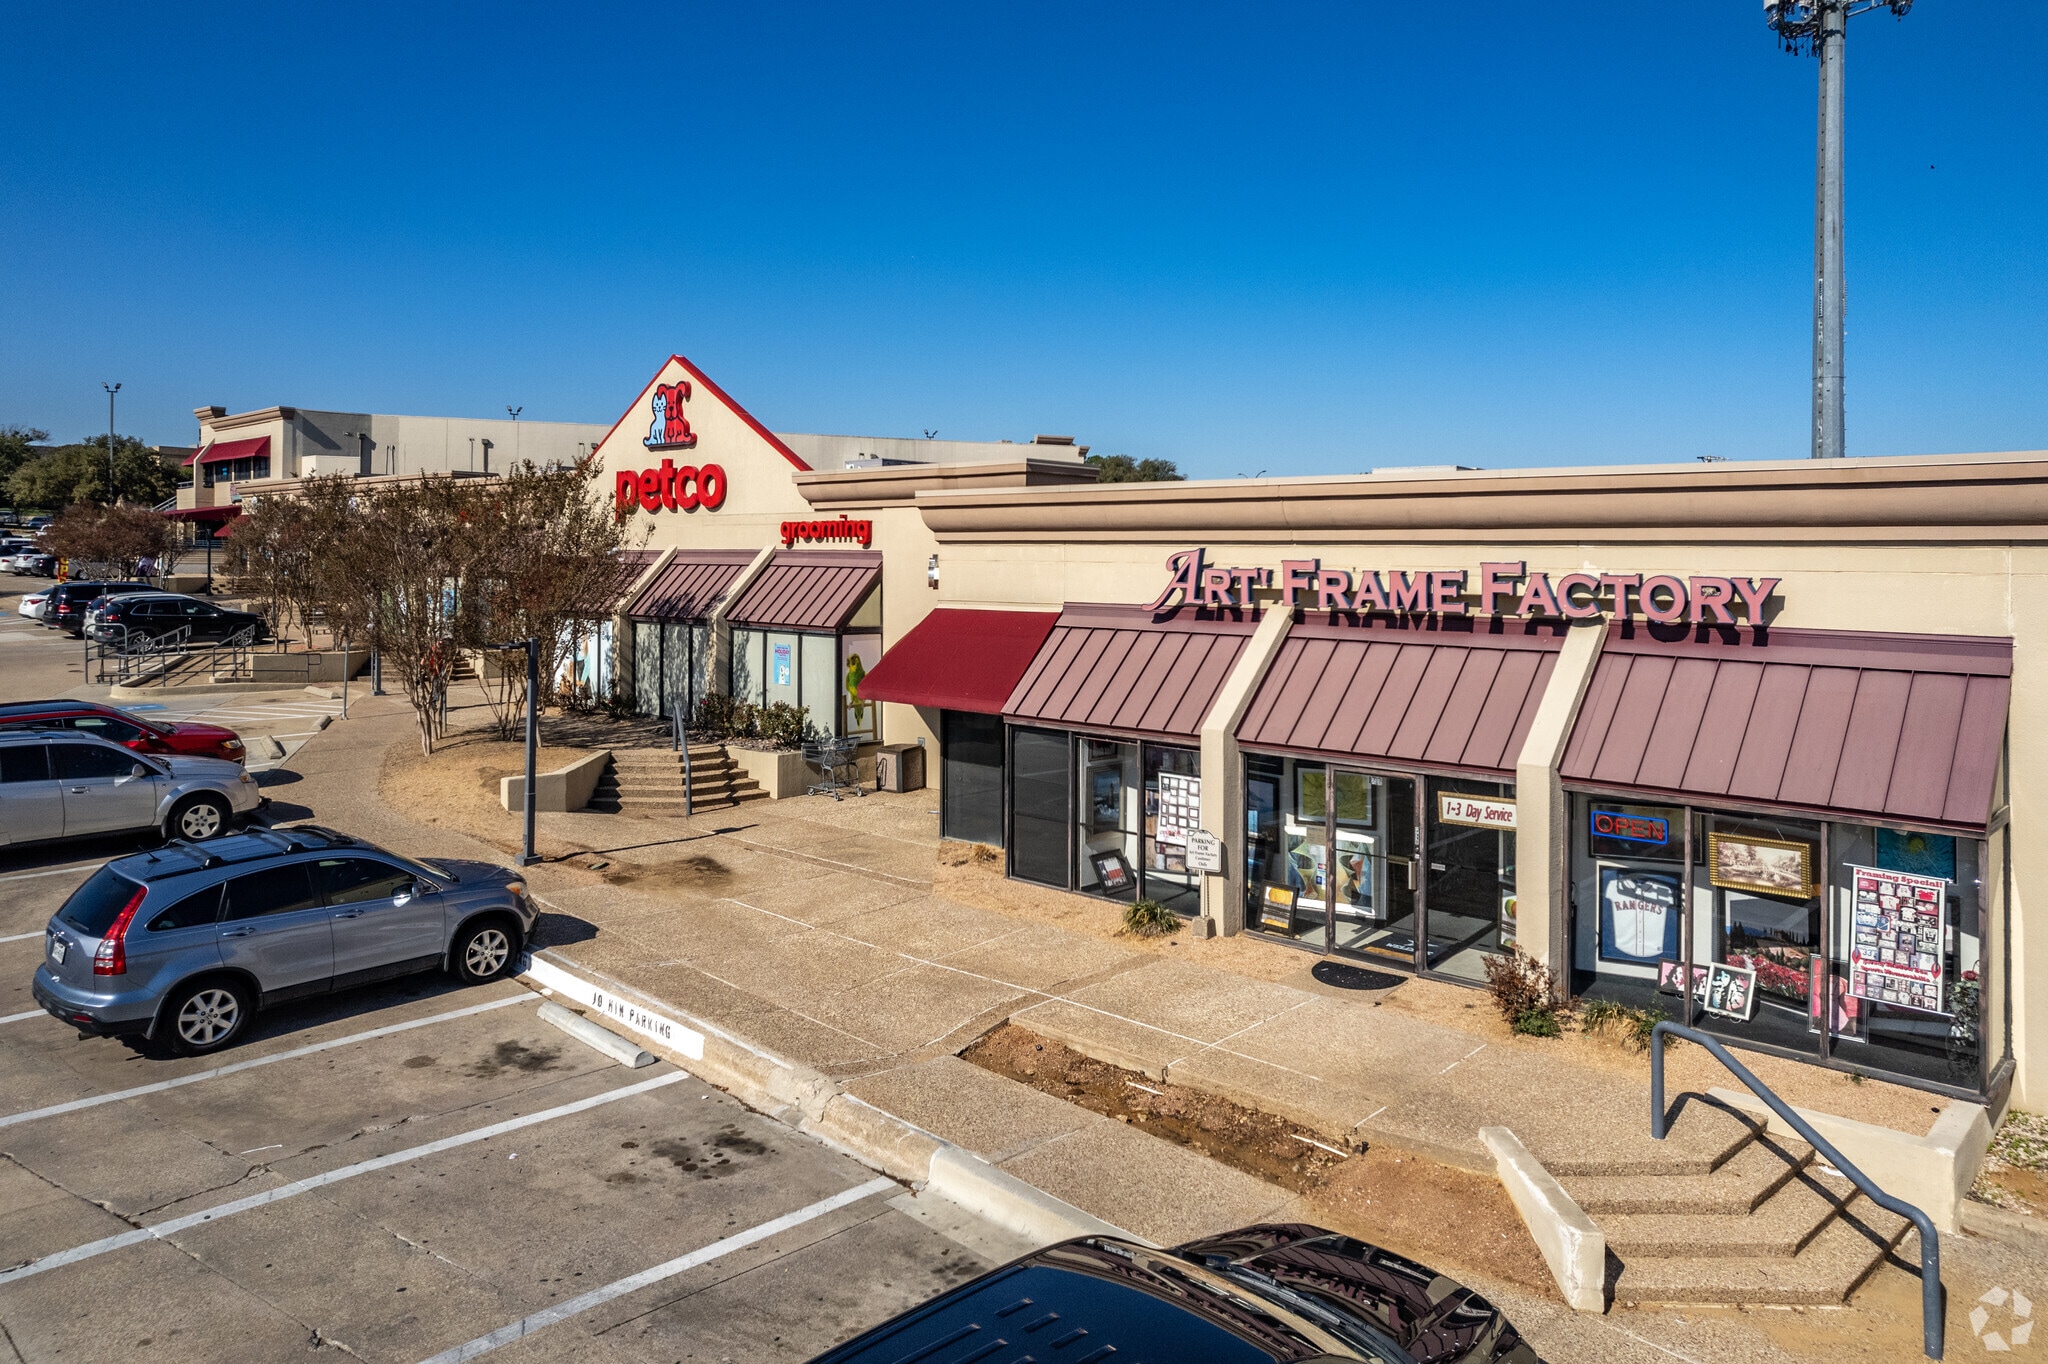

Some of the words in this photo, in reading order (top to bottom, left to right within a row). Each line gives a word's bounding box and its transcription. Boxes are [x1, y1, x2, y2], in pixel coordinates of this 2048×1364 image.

[616, 458, 727, 523] petco
[780, 514, 873, 544] grooming
[1281, 558, 1468, 614] FRAME
[1480, 560, 1782, 626] FACTORY
[1465, 803, 1483, 822] Day
[1484, 805, 1513, 822] Service
[1595, 815, 1664, 840] OPEN
[1191, 838, 1216, 846] PARKING
[1855, 868, 1900, 883] Framing
[1900, 875, 1943, 889] Special!
[1614, 900, 1665, 915] RANGERS
[629, 1009, 672, 1040] PARKING
